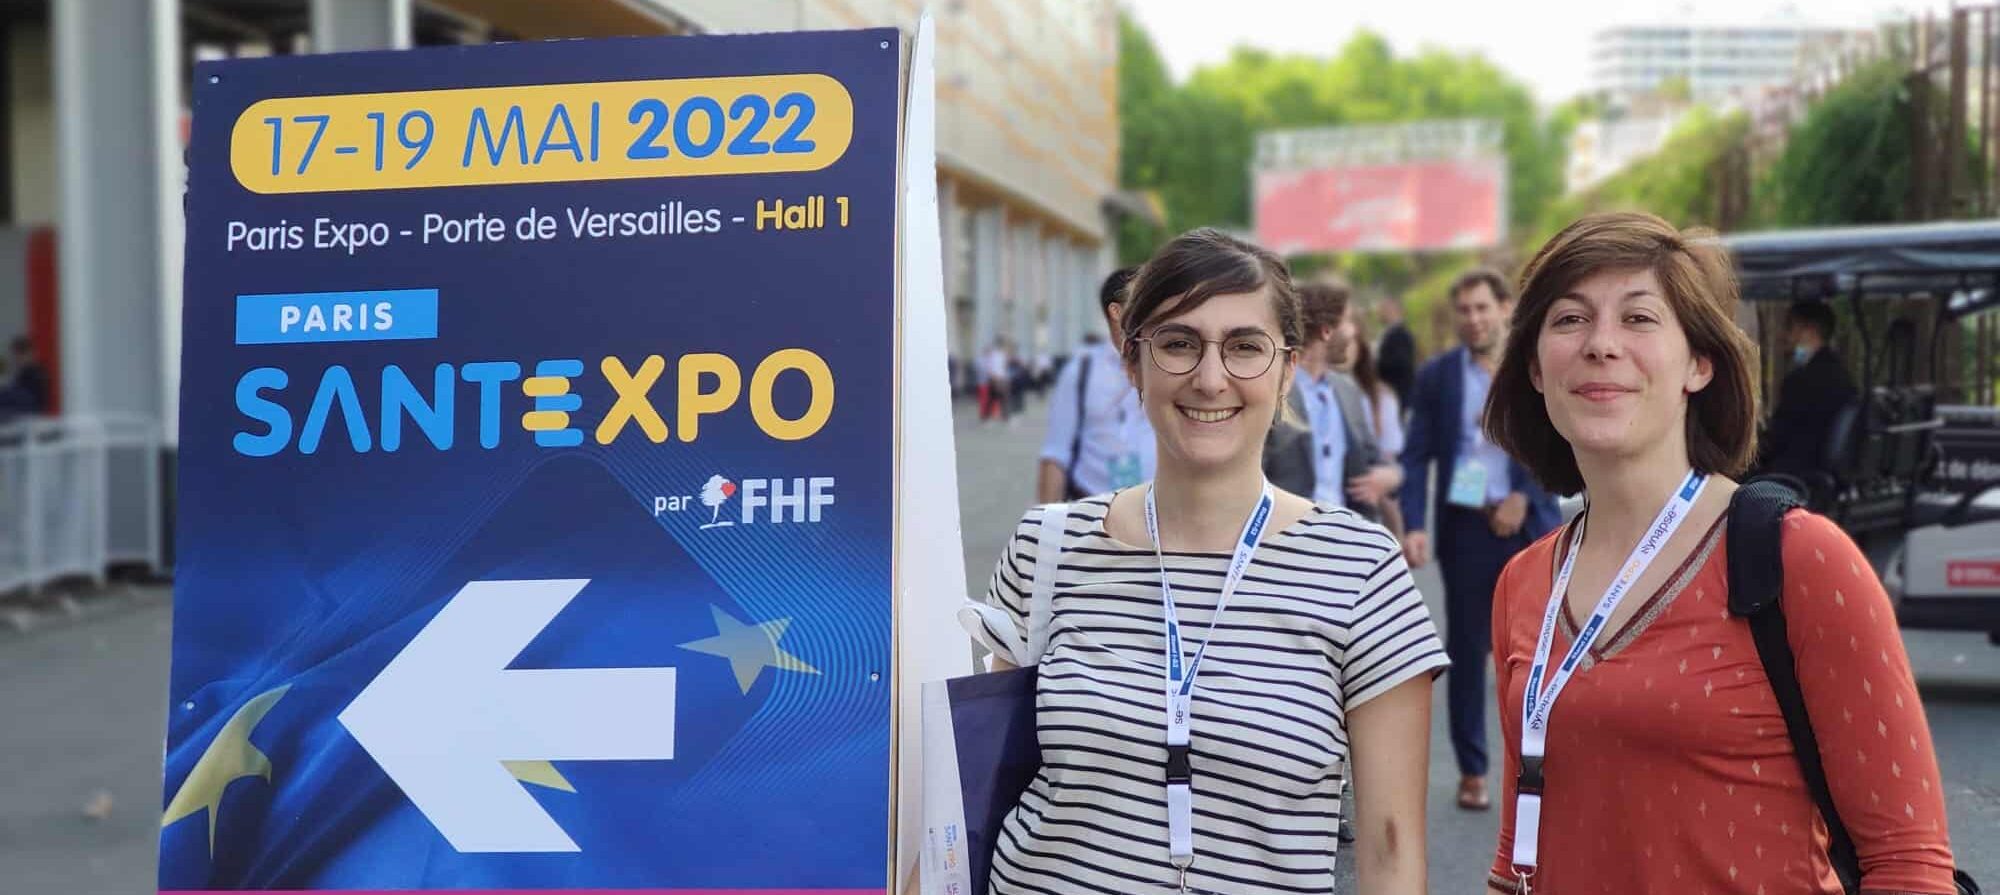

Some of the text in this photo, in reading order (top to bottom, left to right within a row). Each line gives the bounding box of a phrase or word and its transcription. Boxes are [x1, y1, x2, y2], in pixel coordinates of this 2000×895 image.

[263, 91, 817, 177] 17-19 MAI 2022
[226, 217, 304, 252] Paris
[313, 215, 390, 256] Expo
[423, 210, 506, 245] Porte
[515, 206, 559, 241] de
[566, 200, 722, 239] Versailles
[755, 196, 825, 231] Hall
[835, 197, 850, 228] 1
[280, 301, 394, 334] PARIS
[232, 347, 835, 458] SANTEXPO
[653, 476, 836, 525] par FHF
